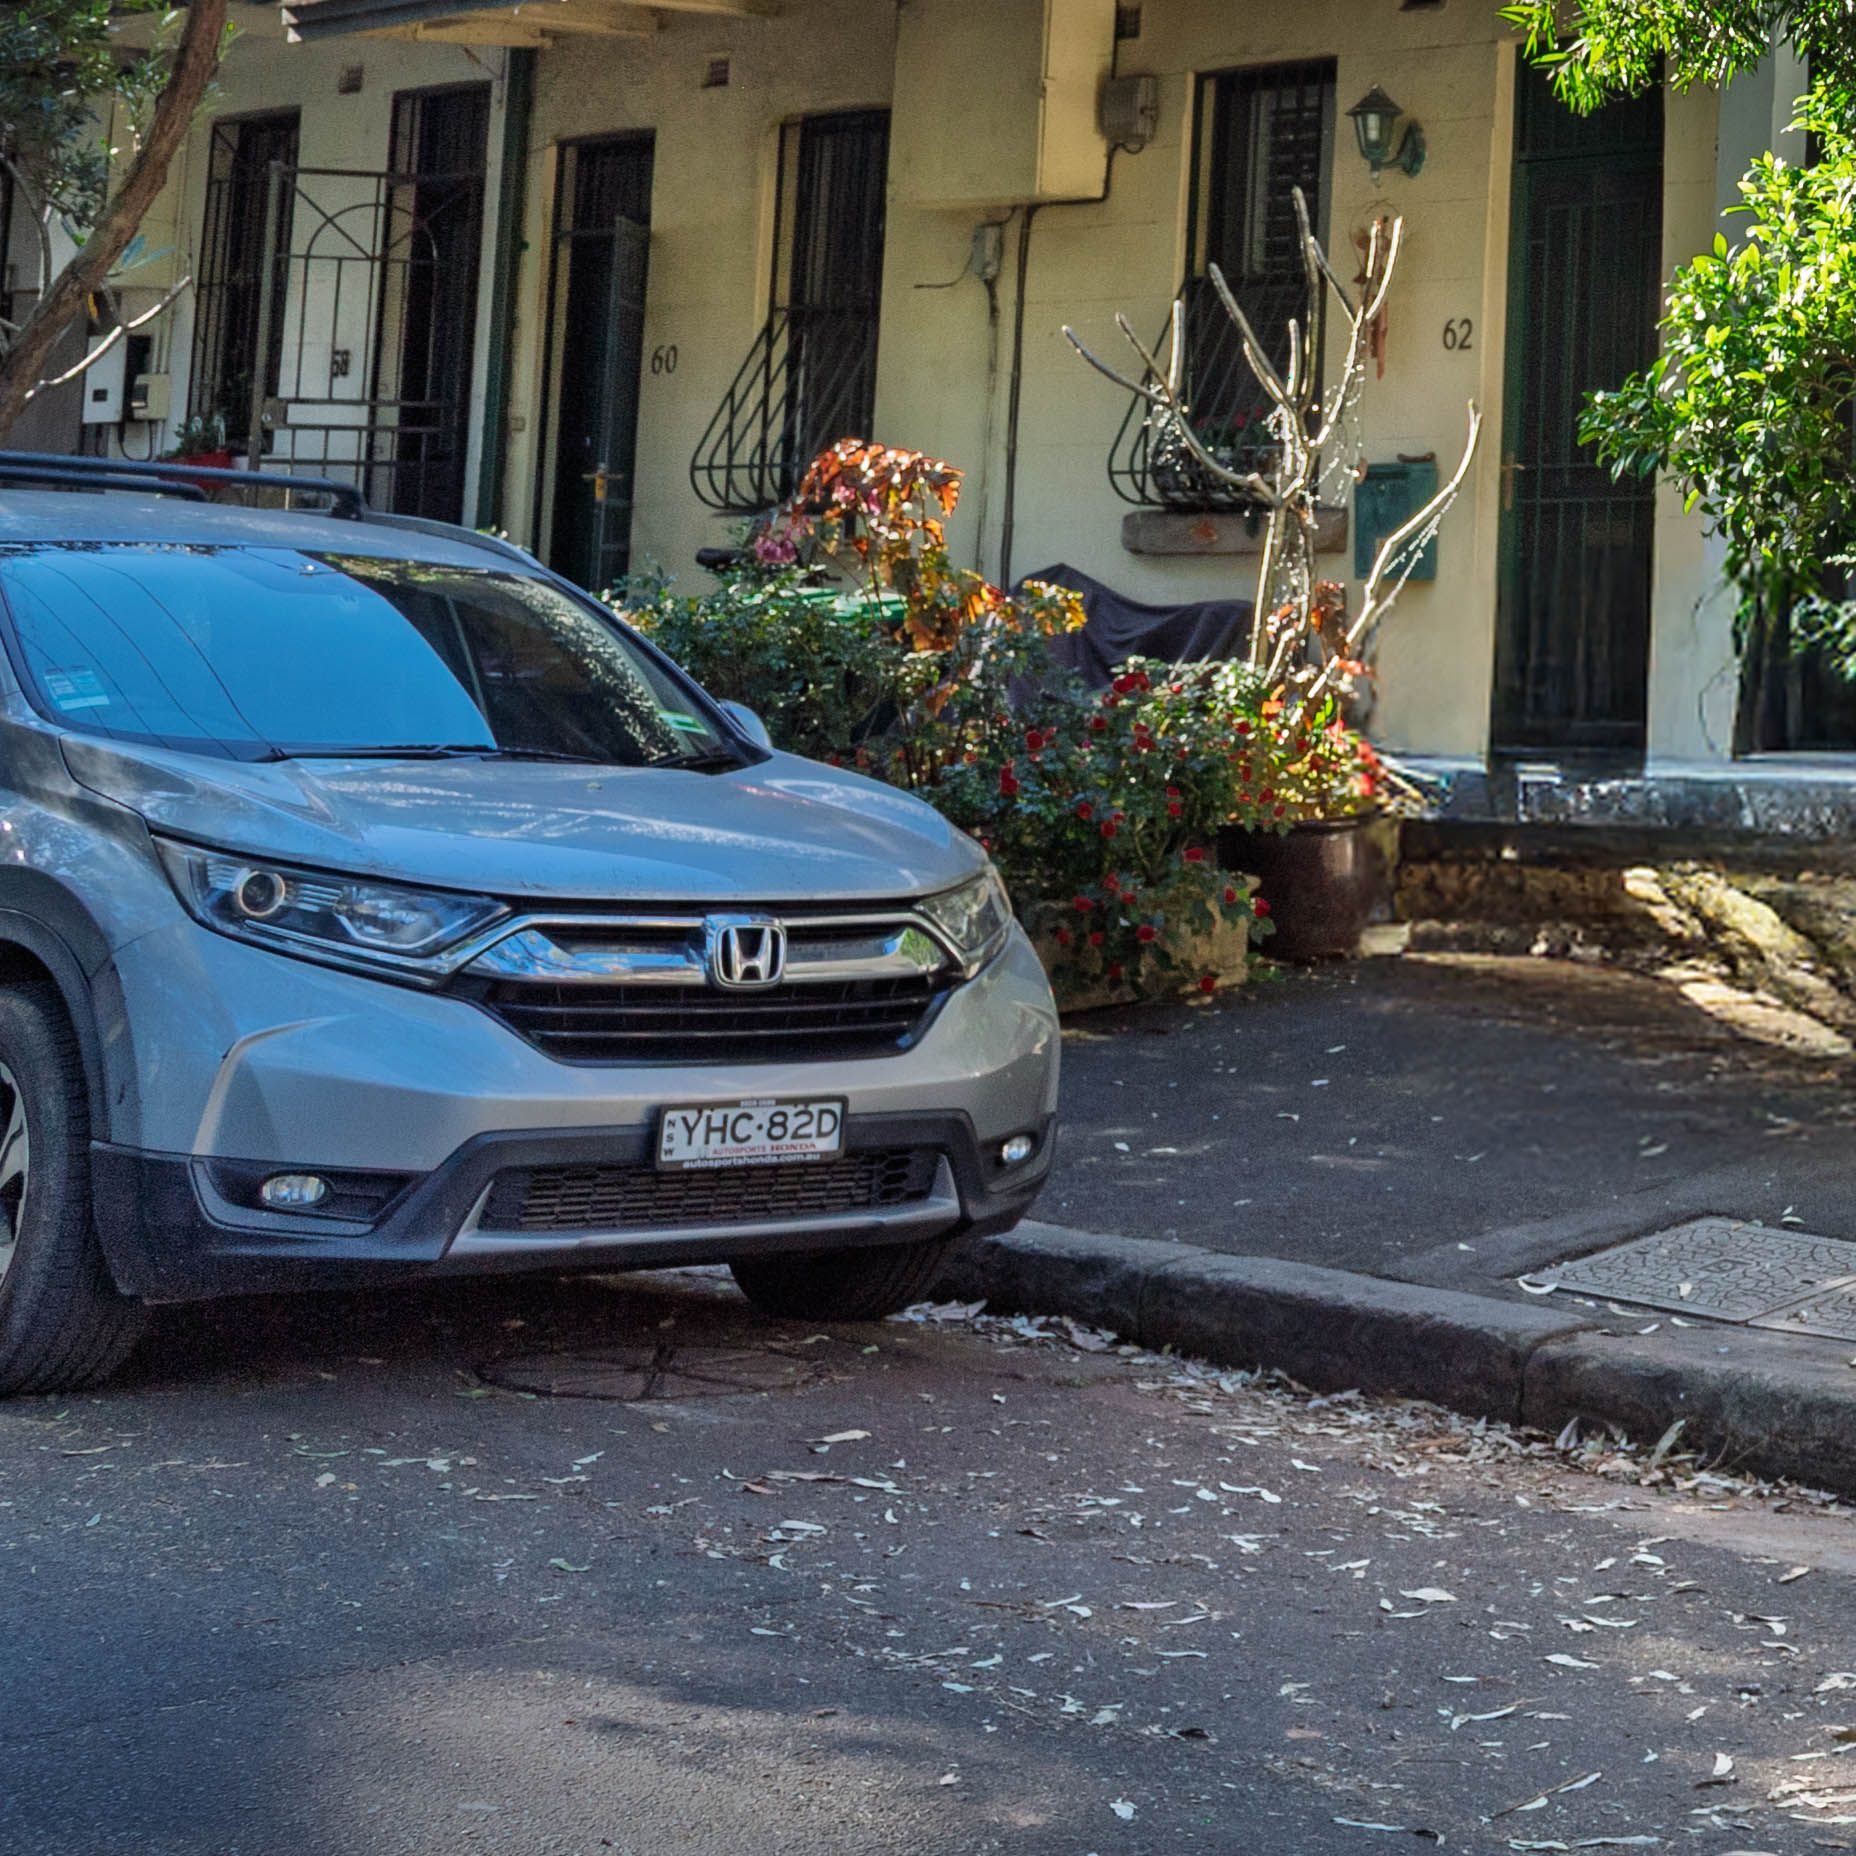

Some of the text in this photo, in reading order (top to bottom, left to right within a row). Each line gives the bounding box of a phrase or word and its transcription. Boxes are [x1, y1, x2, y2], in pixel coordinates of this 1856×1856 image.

[1443, 318, 1473, 350] 62
[652, 345, 677, 374] 60
[712, 1143, 817, 1156] AUTOSPORTS HONDA
[682, 1153, 821, 1169] autosportshonda.com.au
